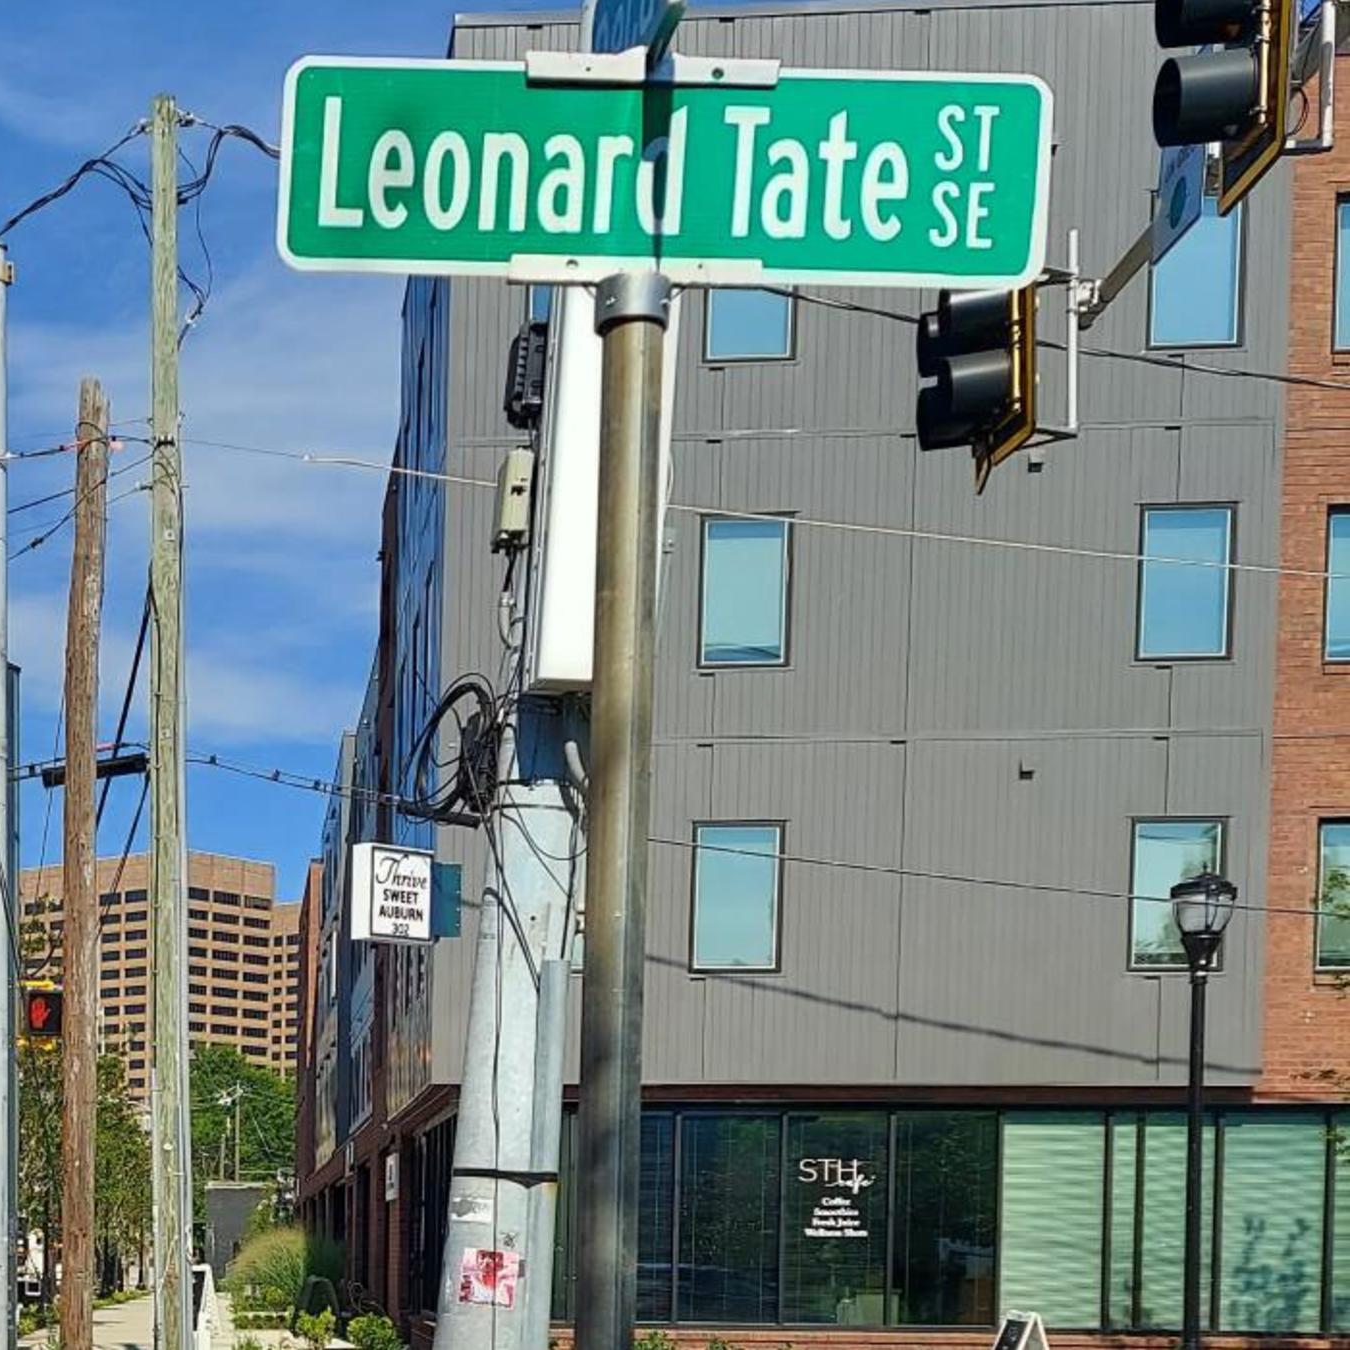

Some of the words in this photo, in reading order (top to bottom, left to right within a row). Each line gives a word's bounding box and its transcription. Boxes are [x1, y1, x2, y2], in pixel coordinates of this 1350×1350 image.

[934, 104, 1001, 172] ST
[318, 96, 688, 236] Leonard
[724, 104, 909, 242] Tate
[928, 180, 996, 249] SE
[376, 855, 427, 889] Thrive
[383, 889, 418, 905] SWEET
[379, 904, 424, 922] AUBURN
